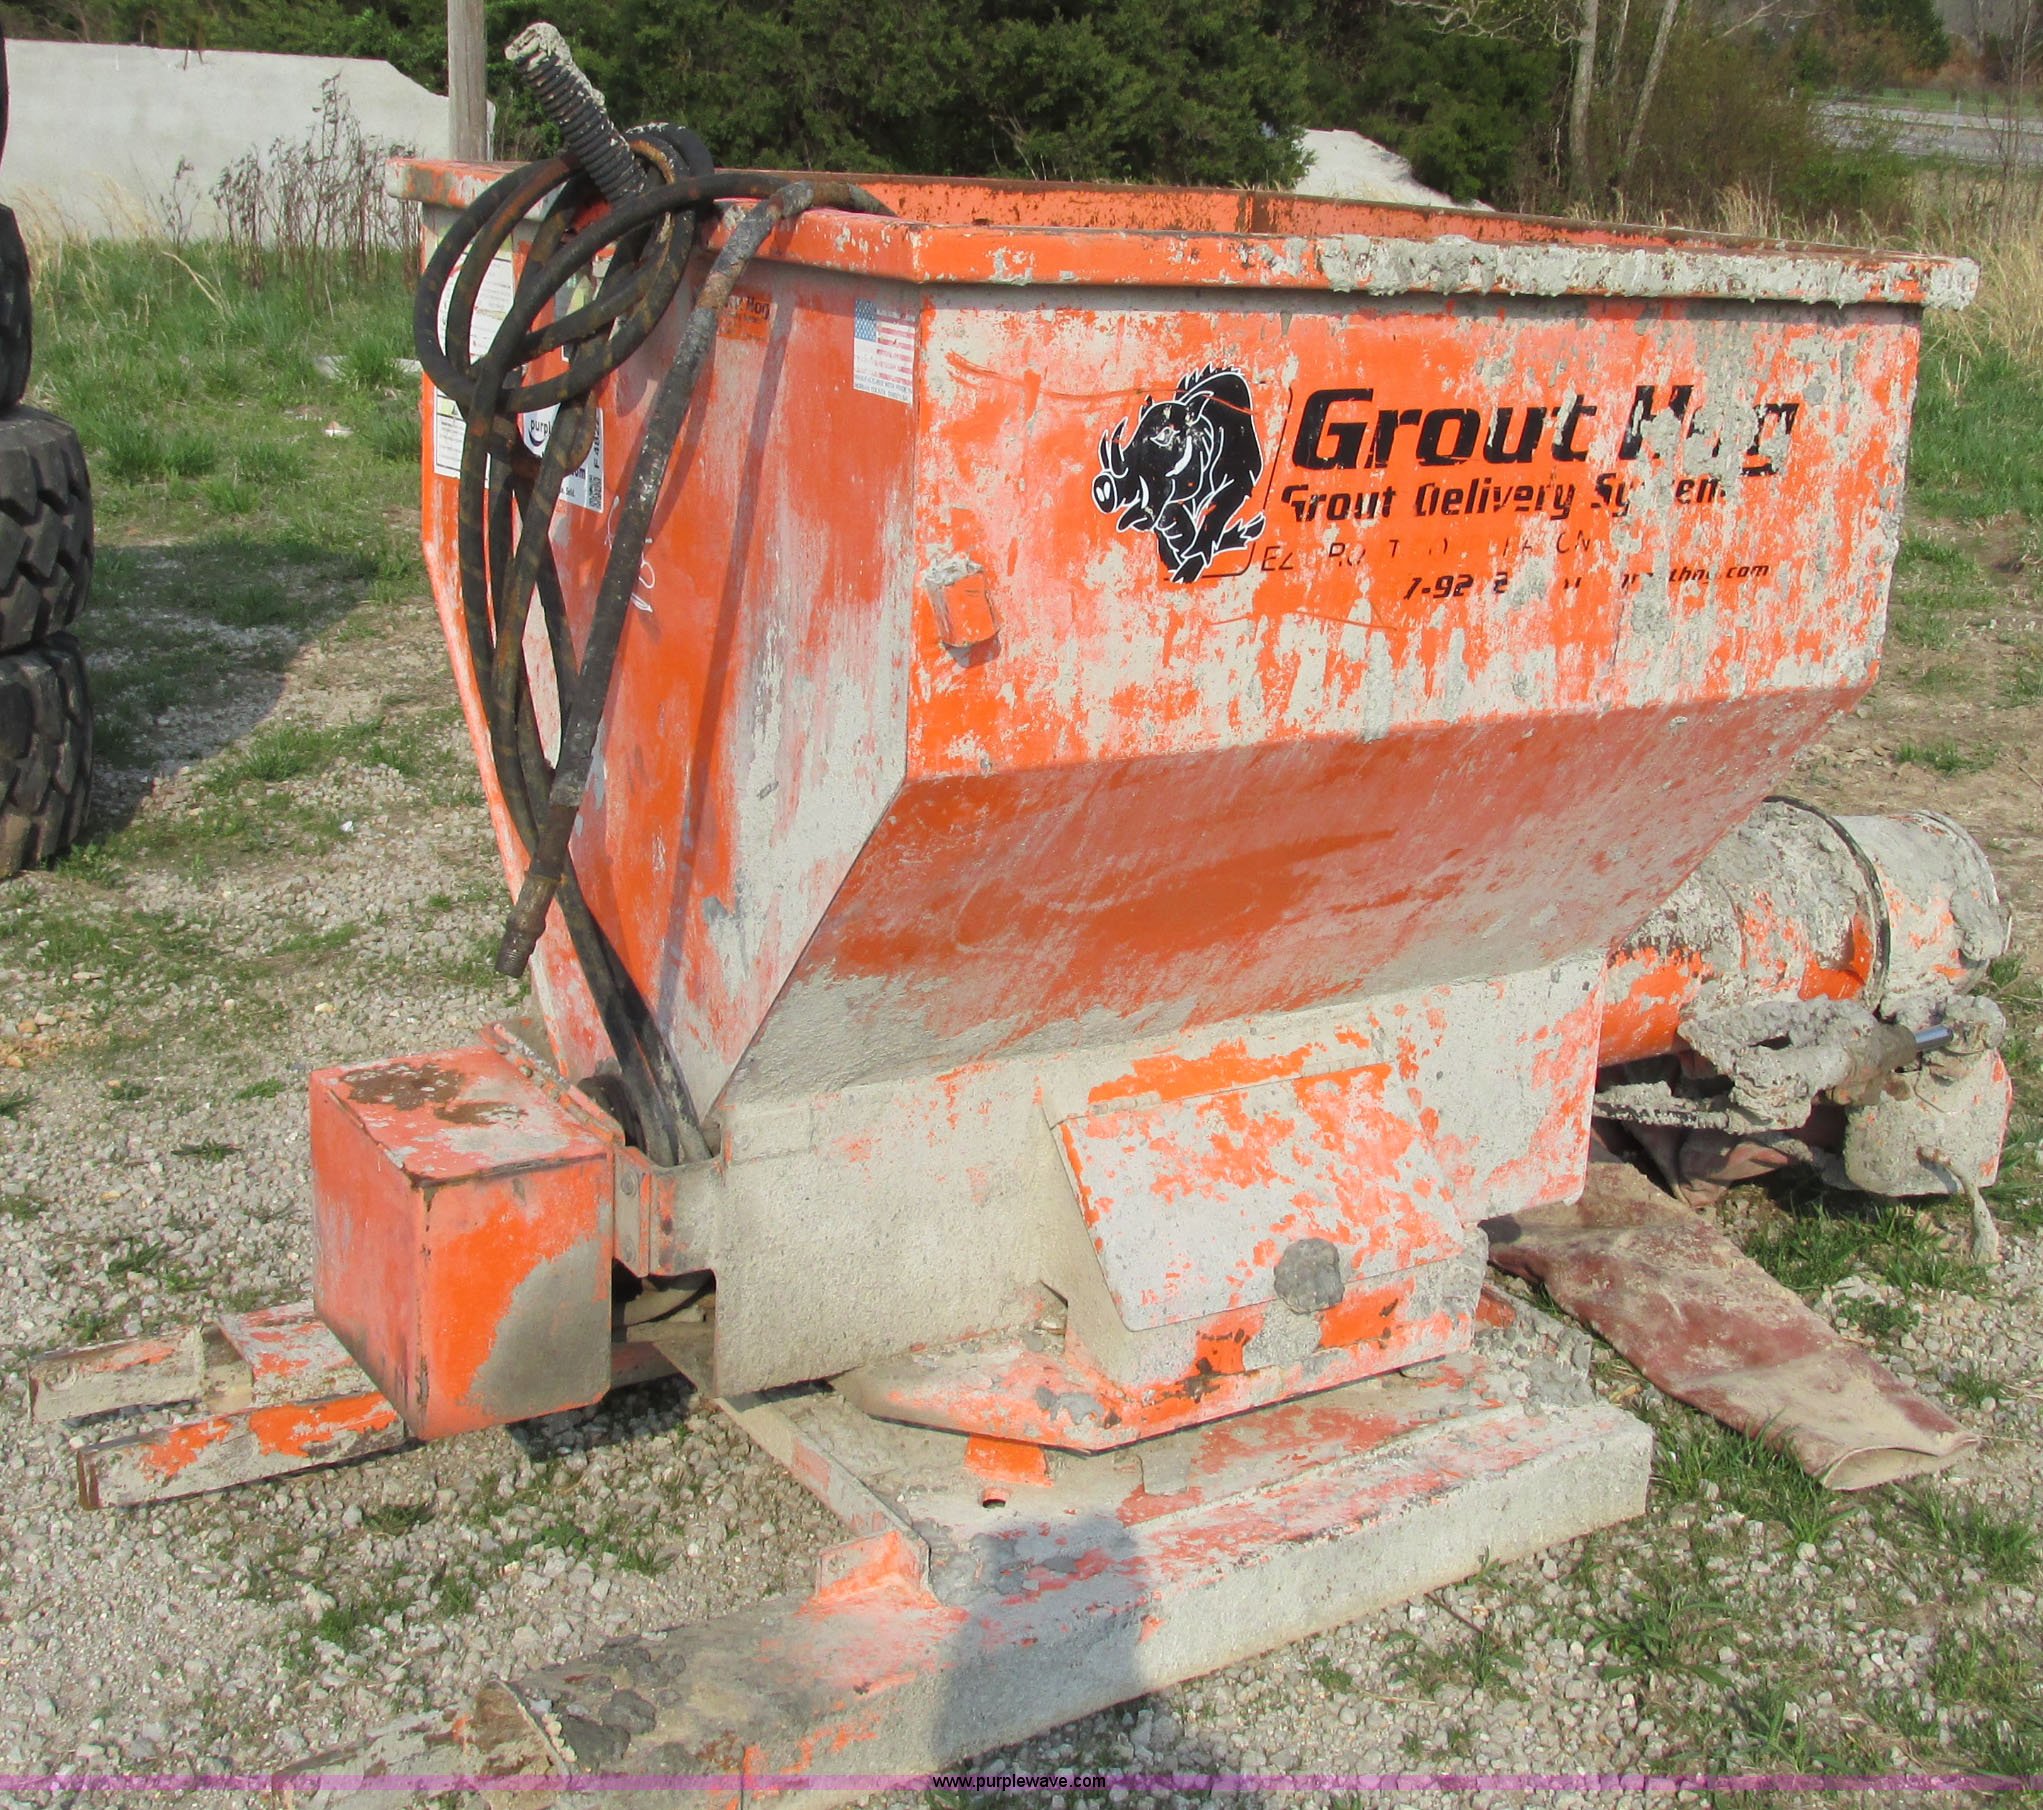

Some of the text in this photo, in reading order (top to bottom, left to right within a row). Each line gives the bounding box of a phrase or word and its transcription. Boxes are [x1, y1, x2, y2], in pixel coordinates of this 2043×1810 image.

[530, 420, 552, 436] purpl
[1292, 384, 1800, 477] Grout Hg
[1281, 484, 1396, 522] Grout
[1414, 477, 1576, 521] Delivery
